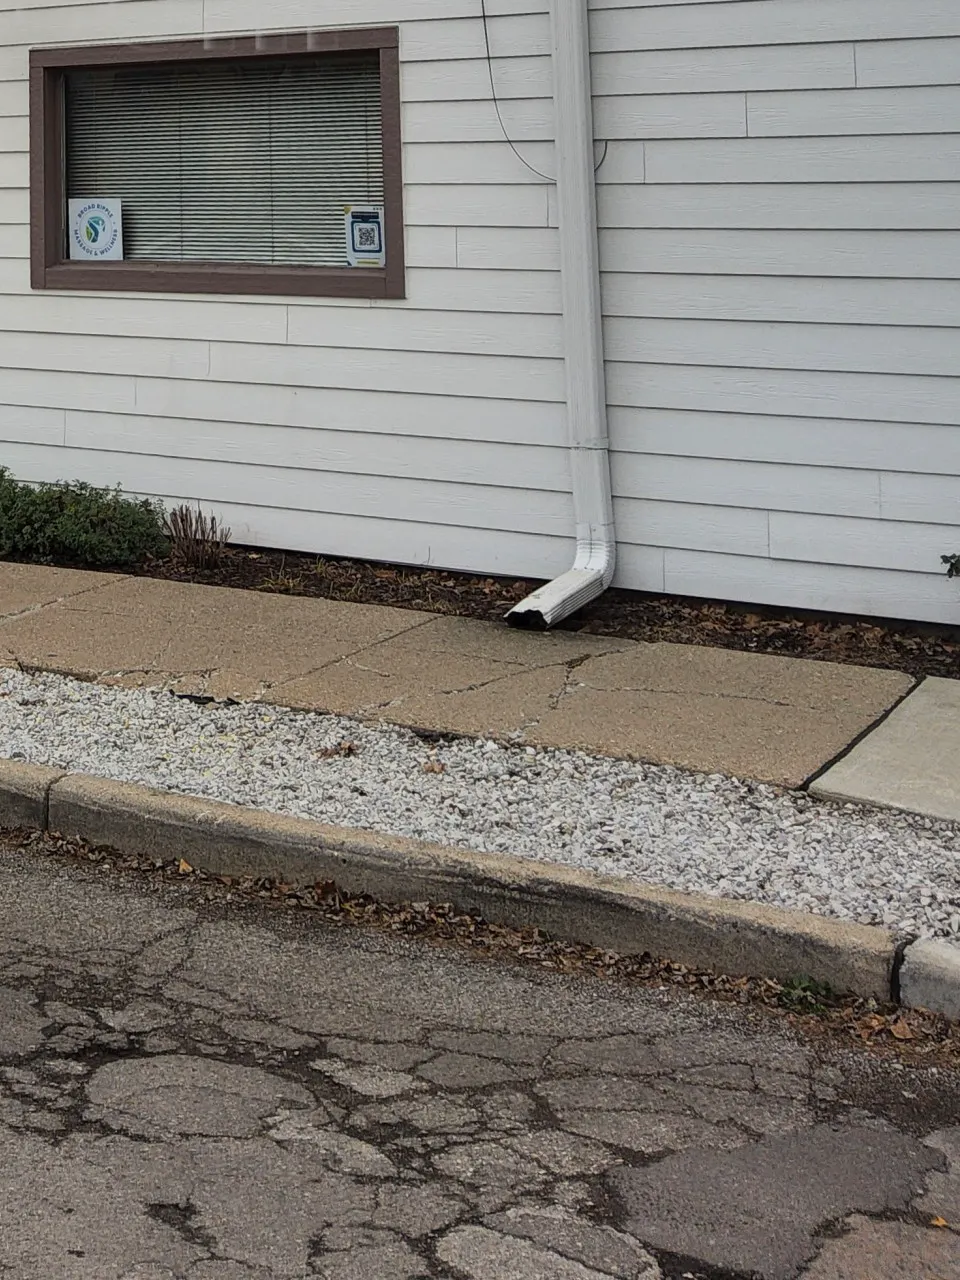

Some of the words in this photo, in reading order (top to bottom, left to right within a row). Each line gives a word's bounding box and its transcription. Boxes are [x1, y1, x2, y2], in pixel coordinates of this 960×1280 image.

[77, 204, 96, 218] BROAD
[97, 204, 113, 218] RIPPLE
[74, 229, 94, 255] MASSAGE
